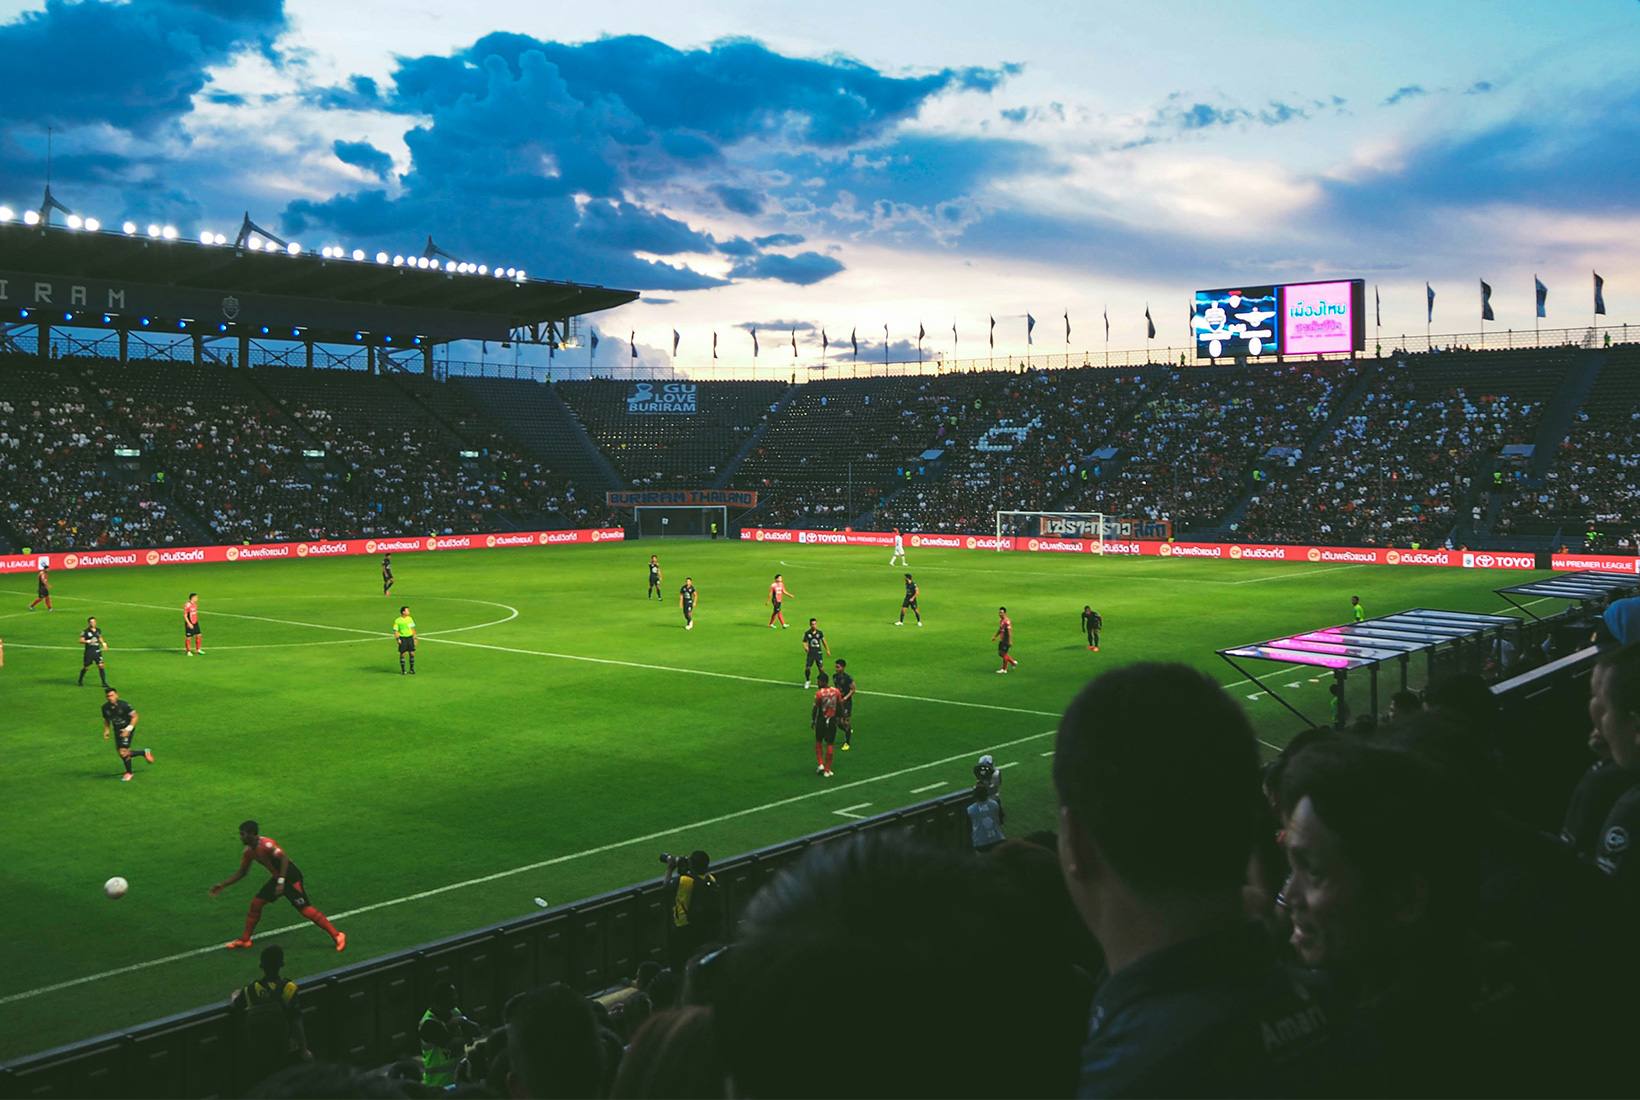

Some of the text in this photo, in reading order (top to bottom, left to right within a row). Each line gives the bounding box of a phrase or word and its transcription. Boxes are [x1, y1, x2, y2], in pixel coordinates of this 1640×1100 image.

[663, 384, 696, 393] GU
[655, 394, 696, 403] LOVE
[629, 403, 696, 412] BURIRAM
[818, 534, 847, 543] TOYOTA
[7, 560, 35, 568] LEAGUE
[1566, 560, 1600, 569] PREMIER
[1601, 561, 1632, 569] LEAGUE
